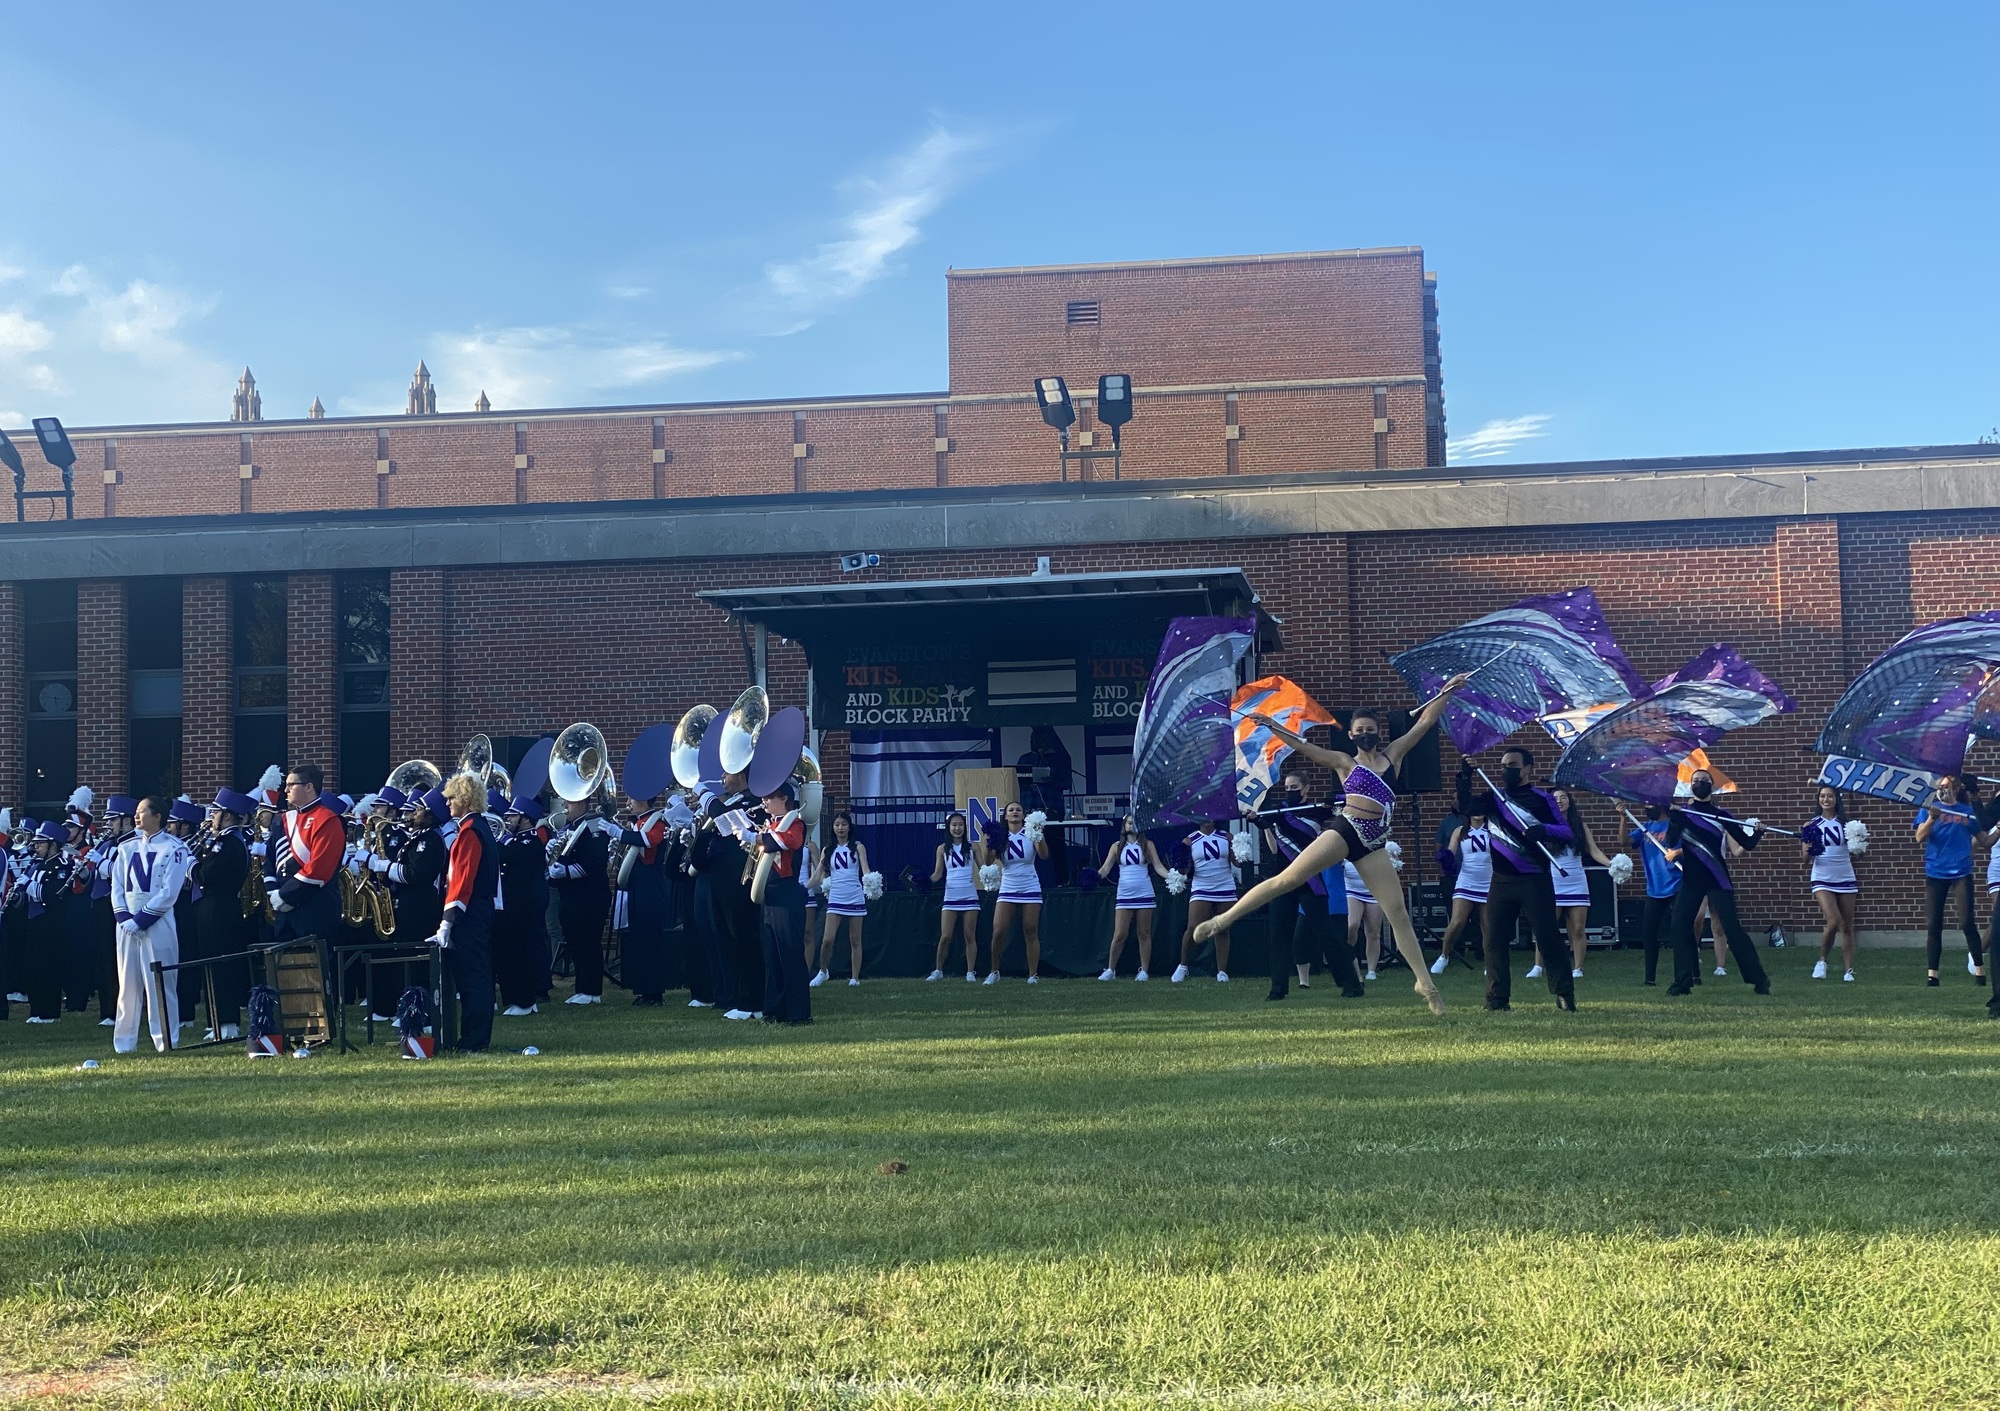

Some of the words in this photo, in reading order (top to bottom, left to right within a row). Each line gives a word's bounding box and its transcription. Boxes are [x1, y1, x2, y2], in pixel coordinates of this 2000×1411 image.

[1090, 638, 1158, 656] EVANS
[845, 692, 883, 707] AND
[887, 686, 940, 706] KIDS
[1092, 685, 1129, 700] AND
[1134, 680, 1149, 698] K
[845, 708, 909, 724] BLOCK
[912, 706, 972, 723] PARTY
[1092, 701, 1143, 718] BLOC
[304, 817, 315, 830] E
[967, 796, 998, 842] N
[1471, 834, 1487, 852] N
[1824, 826, 1841, 846] N
[952, 850, 966, 868] N
[1008, 839, 1024, 860] N
[1126, 848, 1140, 865] N
[1203, 840, 1220, 861] N
[834, 851, 848, 870] N
[127, 851, 157, 893] N
